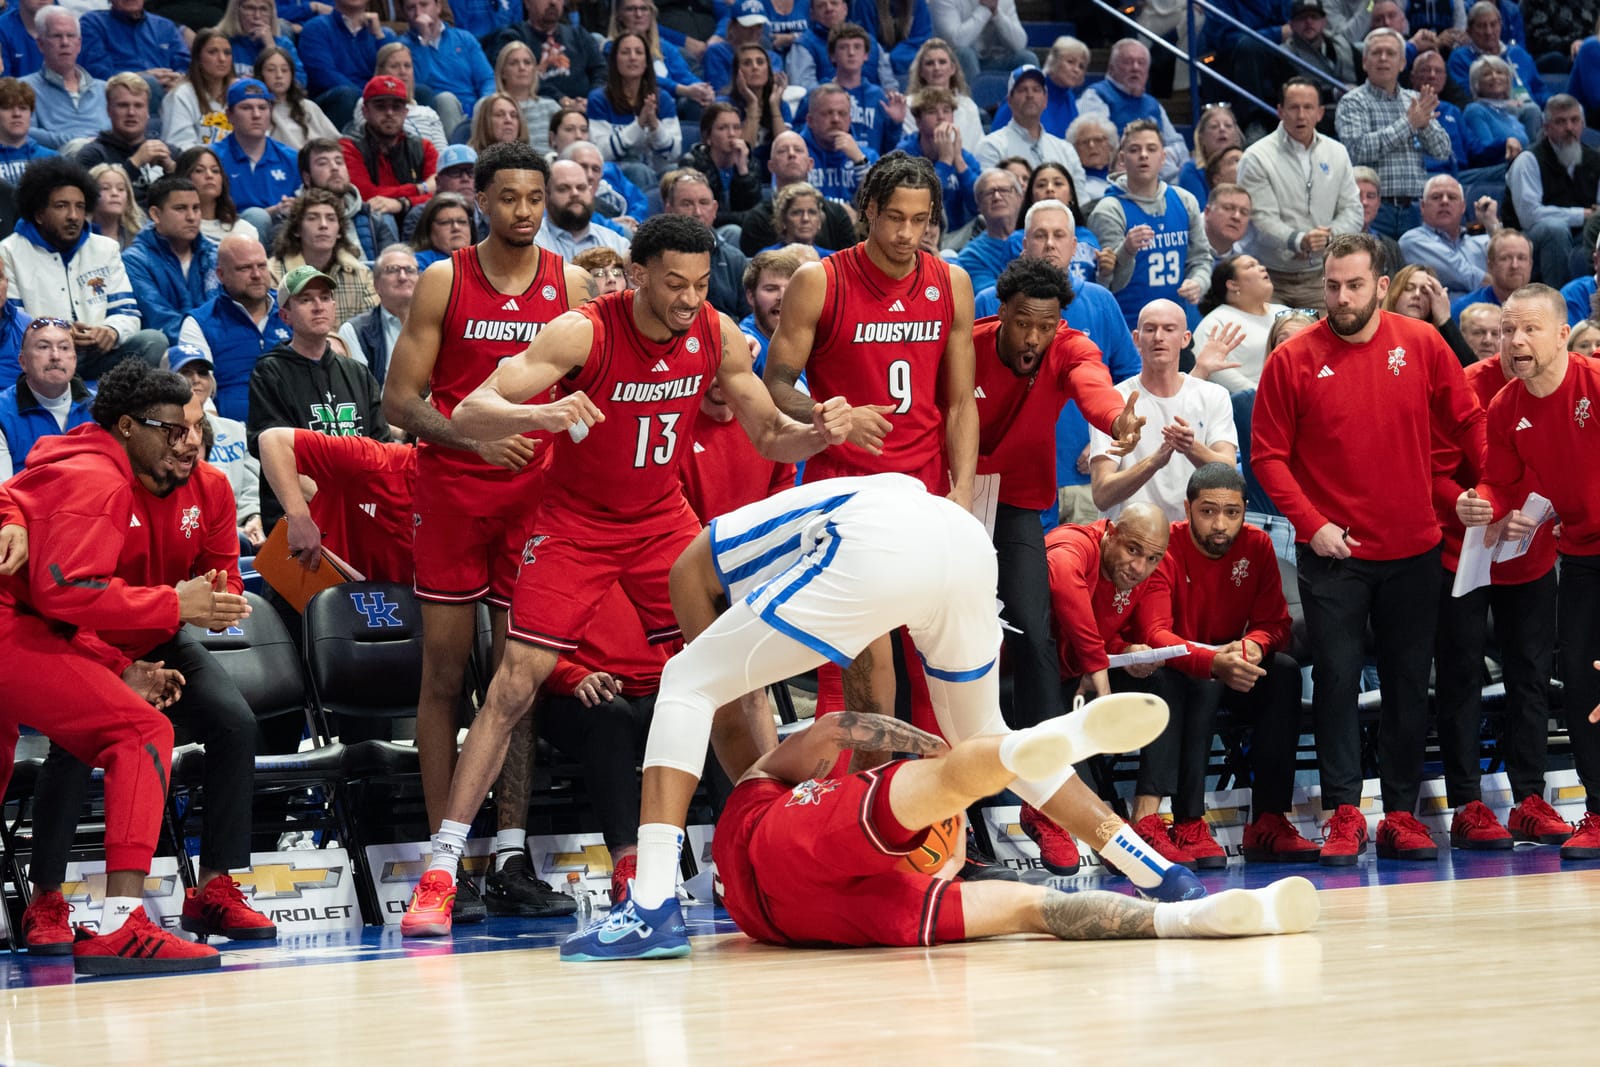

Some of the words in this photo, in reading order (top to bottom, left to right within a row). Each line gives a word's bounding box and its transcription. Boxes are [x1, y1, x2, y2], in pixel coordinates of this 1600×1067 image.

[1148, 250, 1180, 287] 23
[462, 318, 547, 342] LOUISVIL
[852, 320, 942, 343] LOUISVILLE
[609, 374, 703, 403] LOUISVILLE
[888, 359, 912, 414] 9
[208, 440, 246, 463] UCKY
[633, 412, 681, 469] 13
[350, 592, 403, 628] UK
[256, 904, 353, 923] VROLET
